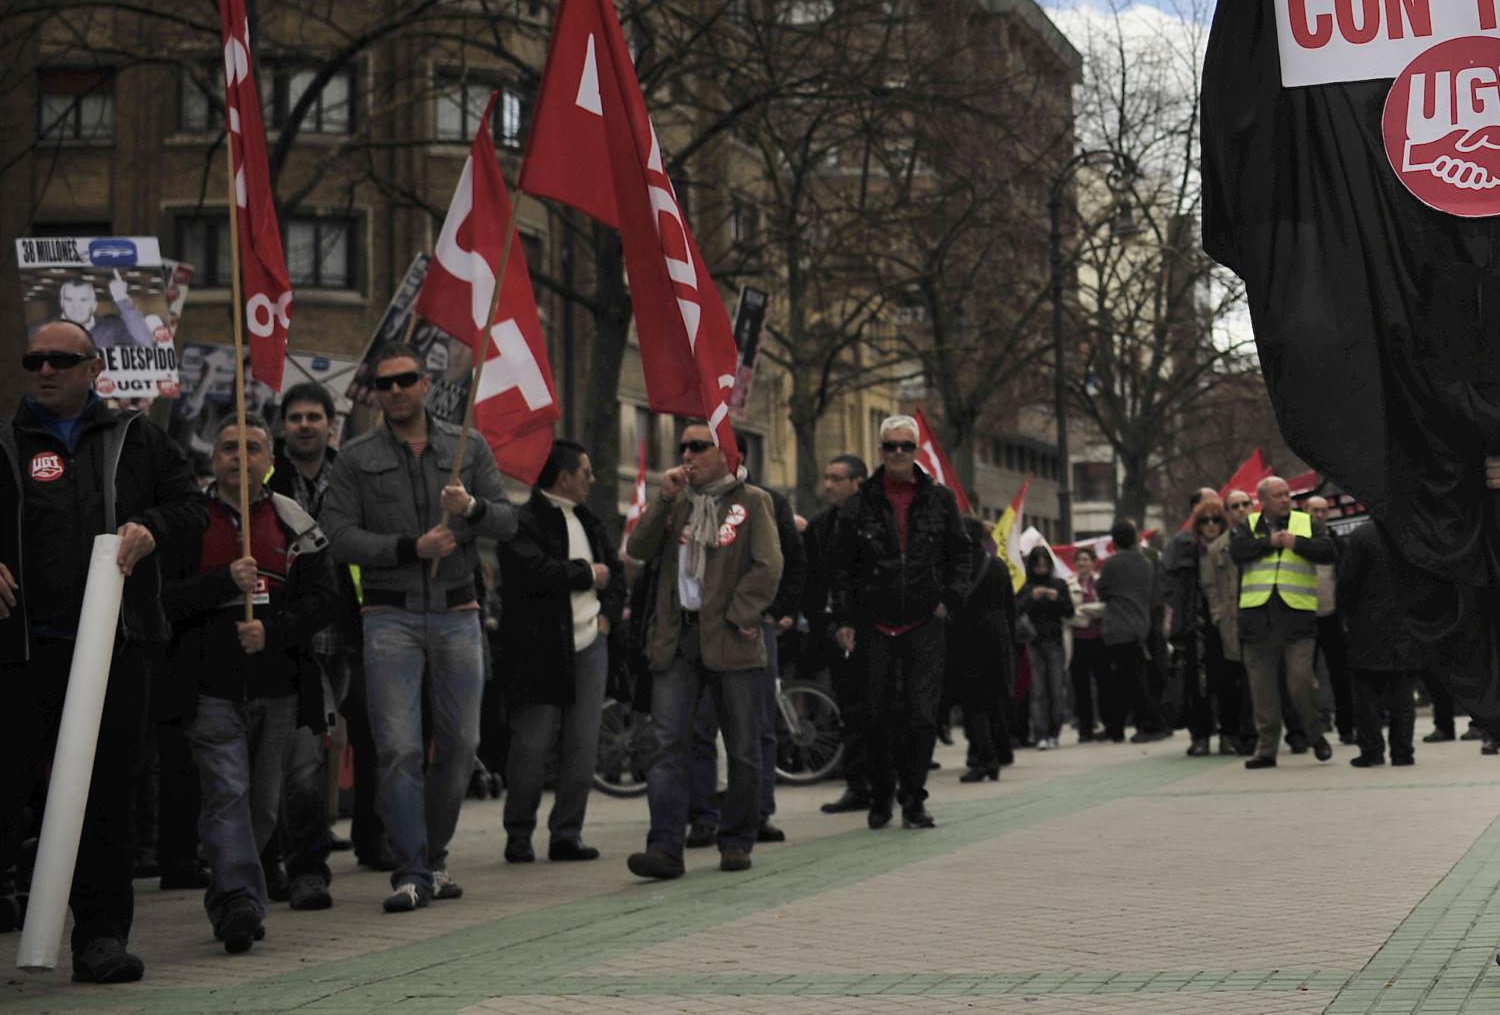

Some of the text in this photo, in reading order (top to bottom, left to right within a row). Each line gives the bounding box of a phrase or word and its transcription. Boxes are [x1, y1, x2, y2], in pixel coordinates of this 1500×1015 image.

[22, 240, 36, 264] 38
[120, 347, 177, 371] DESPIDO
[117, 379, 152, 391] UGT
[32, 455, 59, 472] UGT
